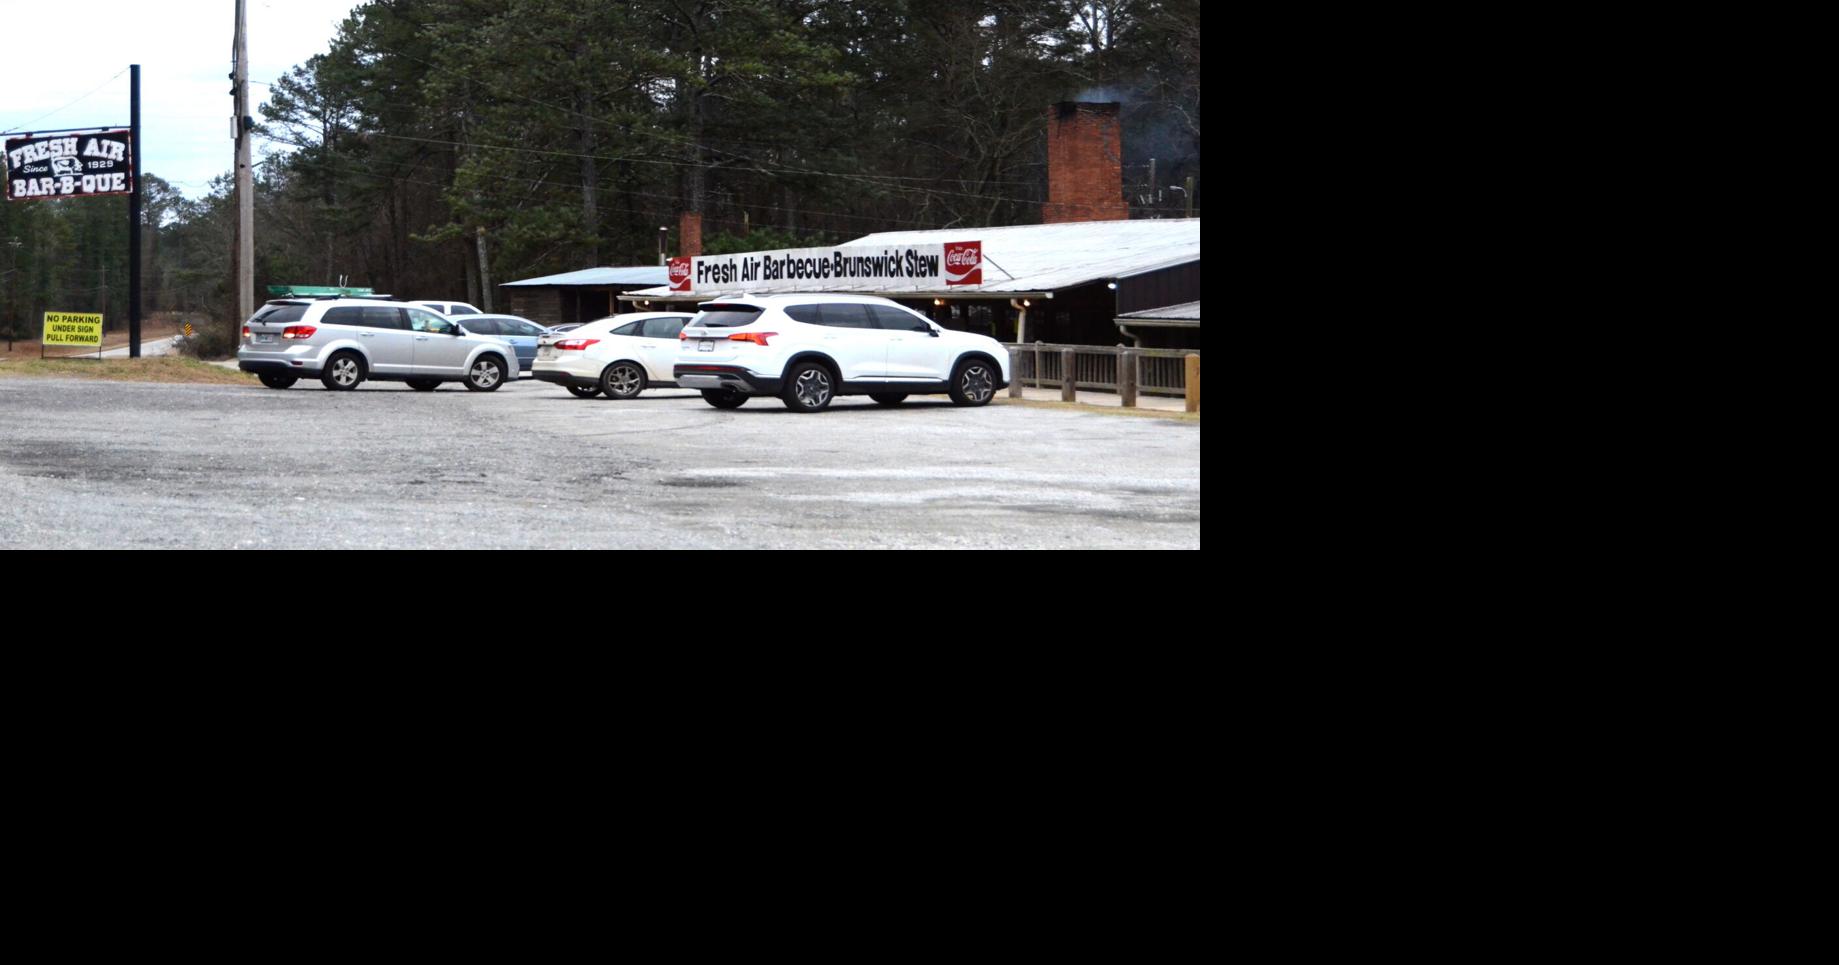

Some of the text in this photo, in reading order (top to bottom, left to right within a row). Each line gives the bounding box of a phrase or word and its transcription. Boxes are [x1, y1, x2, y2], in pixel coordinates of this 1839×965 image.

[9, 137, 125, 169] FRESH AIR
[23, 160, 114, 173] Since 1929
[13, 173, 125, 197] BAR-B-QUE
[697, 258, 737, 284] Fresh
[741, 256, 761, 282] Air
[905, 248, 939, 278] Stew
[62, 315, 100, 324] PARKING
[52, 324, 94, 333] UNDER SIGN
[65, 334, 99, 343] FORWARD
